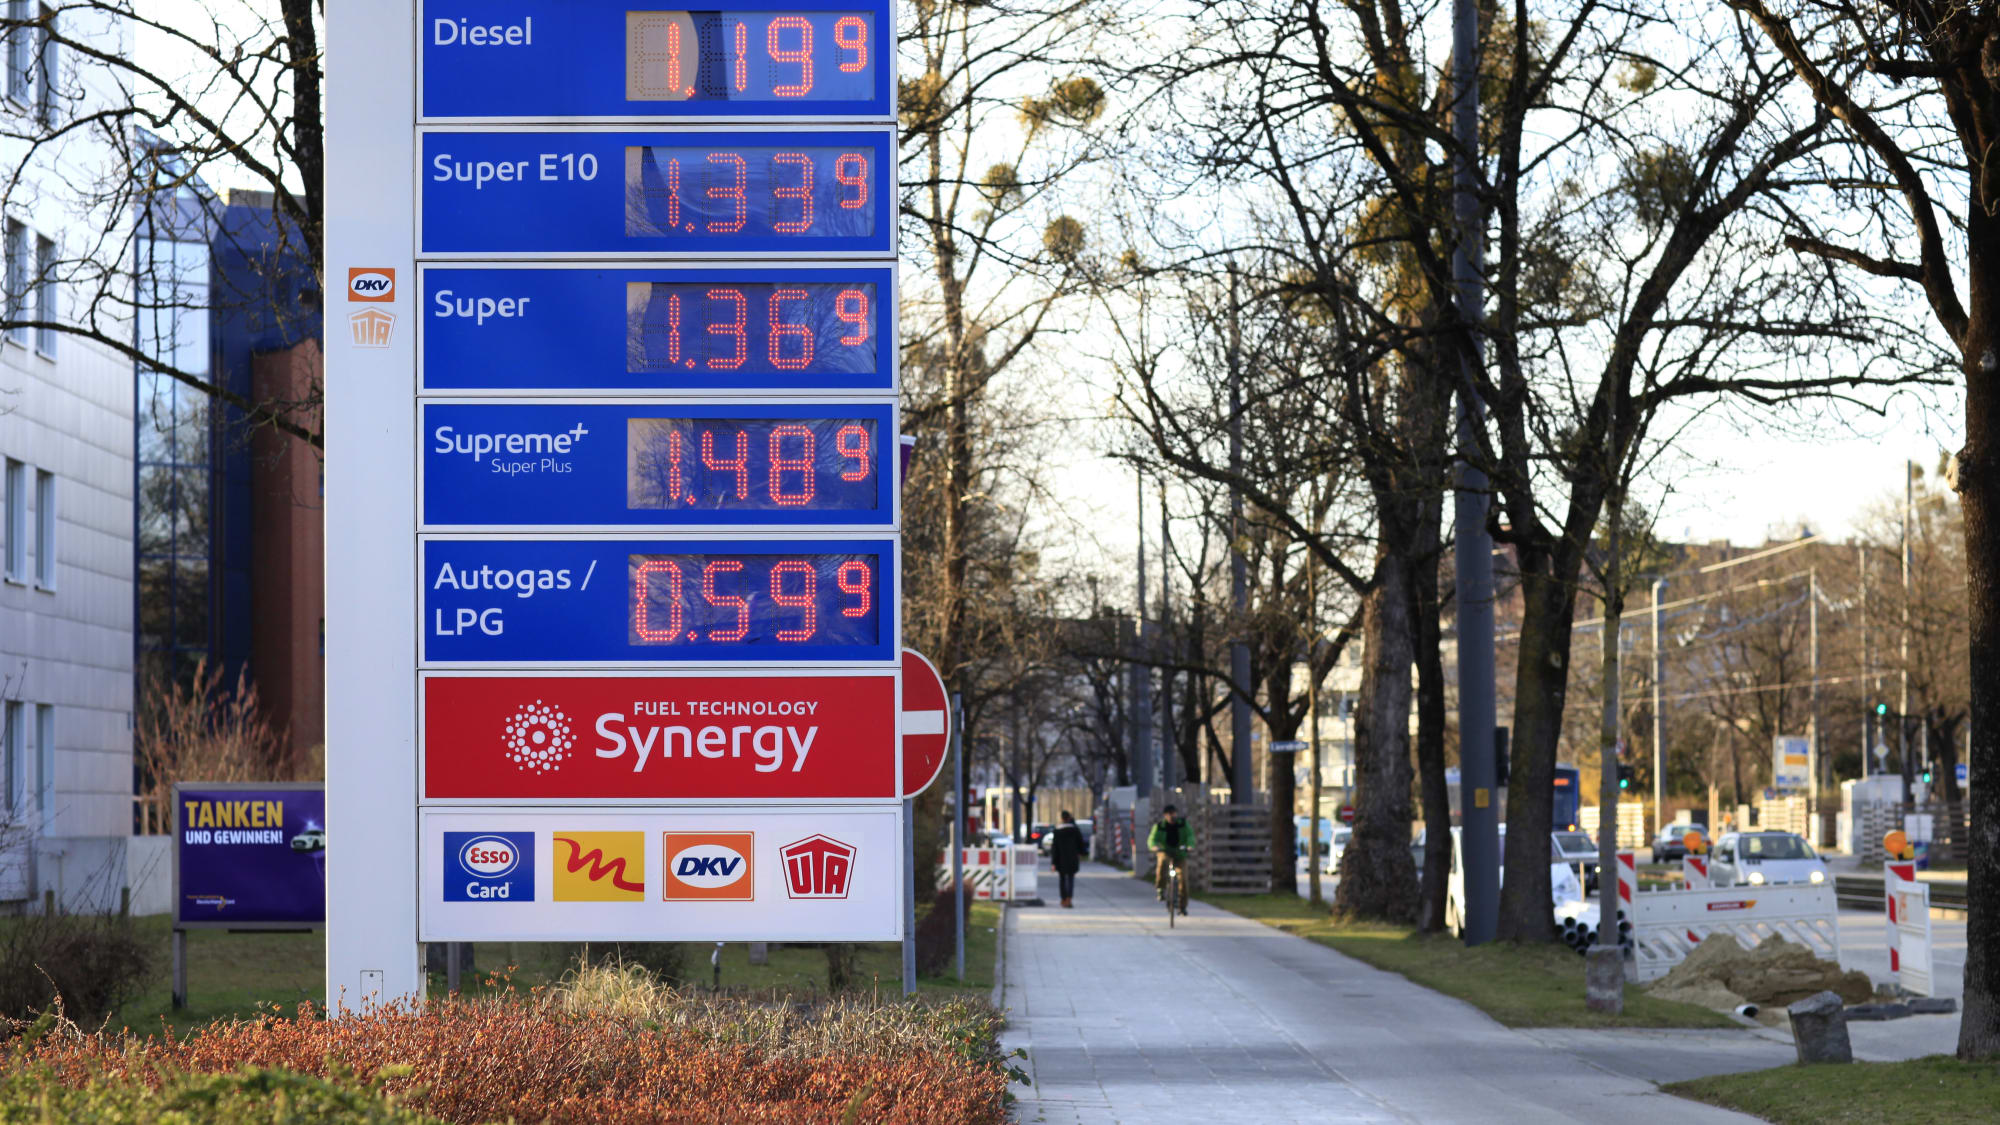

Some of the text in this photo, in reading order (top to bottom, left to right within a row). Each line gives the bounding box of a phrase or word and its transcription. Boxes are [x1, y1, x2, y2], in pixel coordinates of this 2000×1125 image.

[434, 17, 532, 46] Diesel
[433, 154, 529, 189] Super
[539, 153, 598, 181] E10
[354, 279, 389, 291] DKV
[434, 290, 530, 325] Super
[351, 310, 392, 345] UTA
[491, 458, 572, 477] Super Plus
[434, 563, 571, 598] Autogas
[435, 608, 504, 636] LPG
[634, 701, 818, 716] FUEL TECHNOLOGY
[595, 713, 818, 773] Synergy
[185, 801, 283, 828] TANKEN
[185, 830, 283, 844] UND GEWINNEN!
[470, 847, 510, 864] Esso
[677, 857, 741, 876] DKV
[785, 838, 850, 894] UTA
[466, 881, 510, 899] Card
